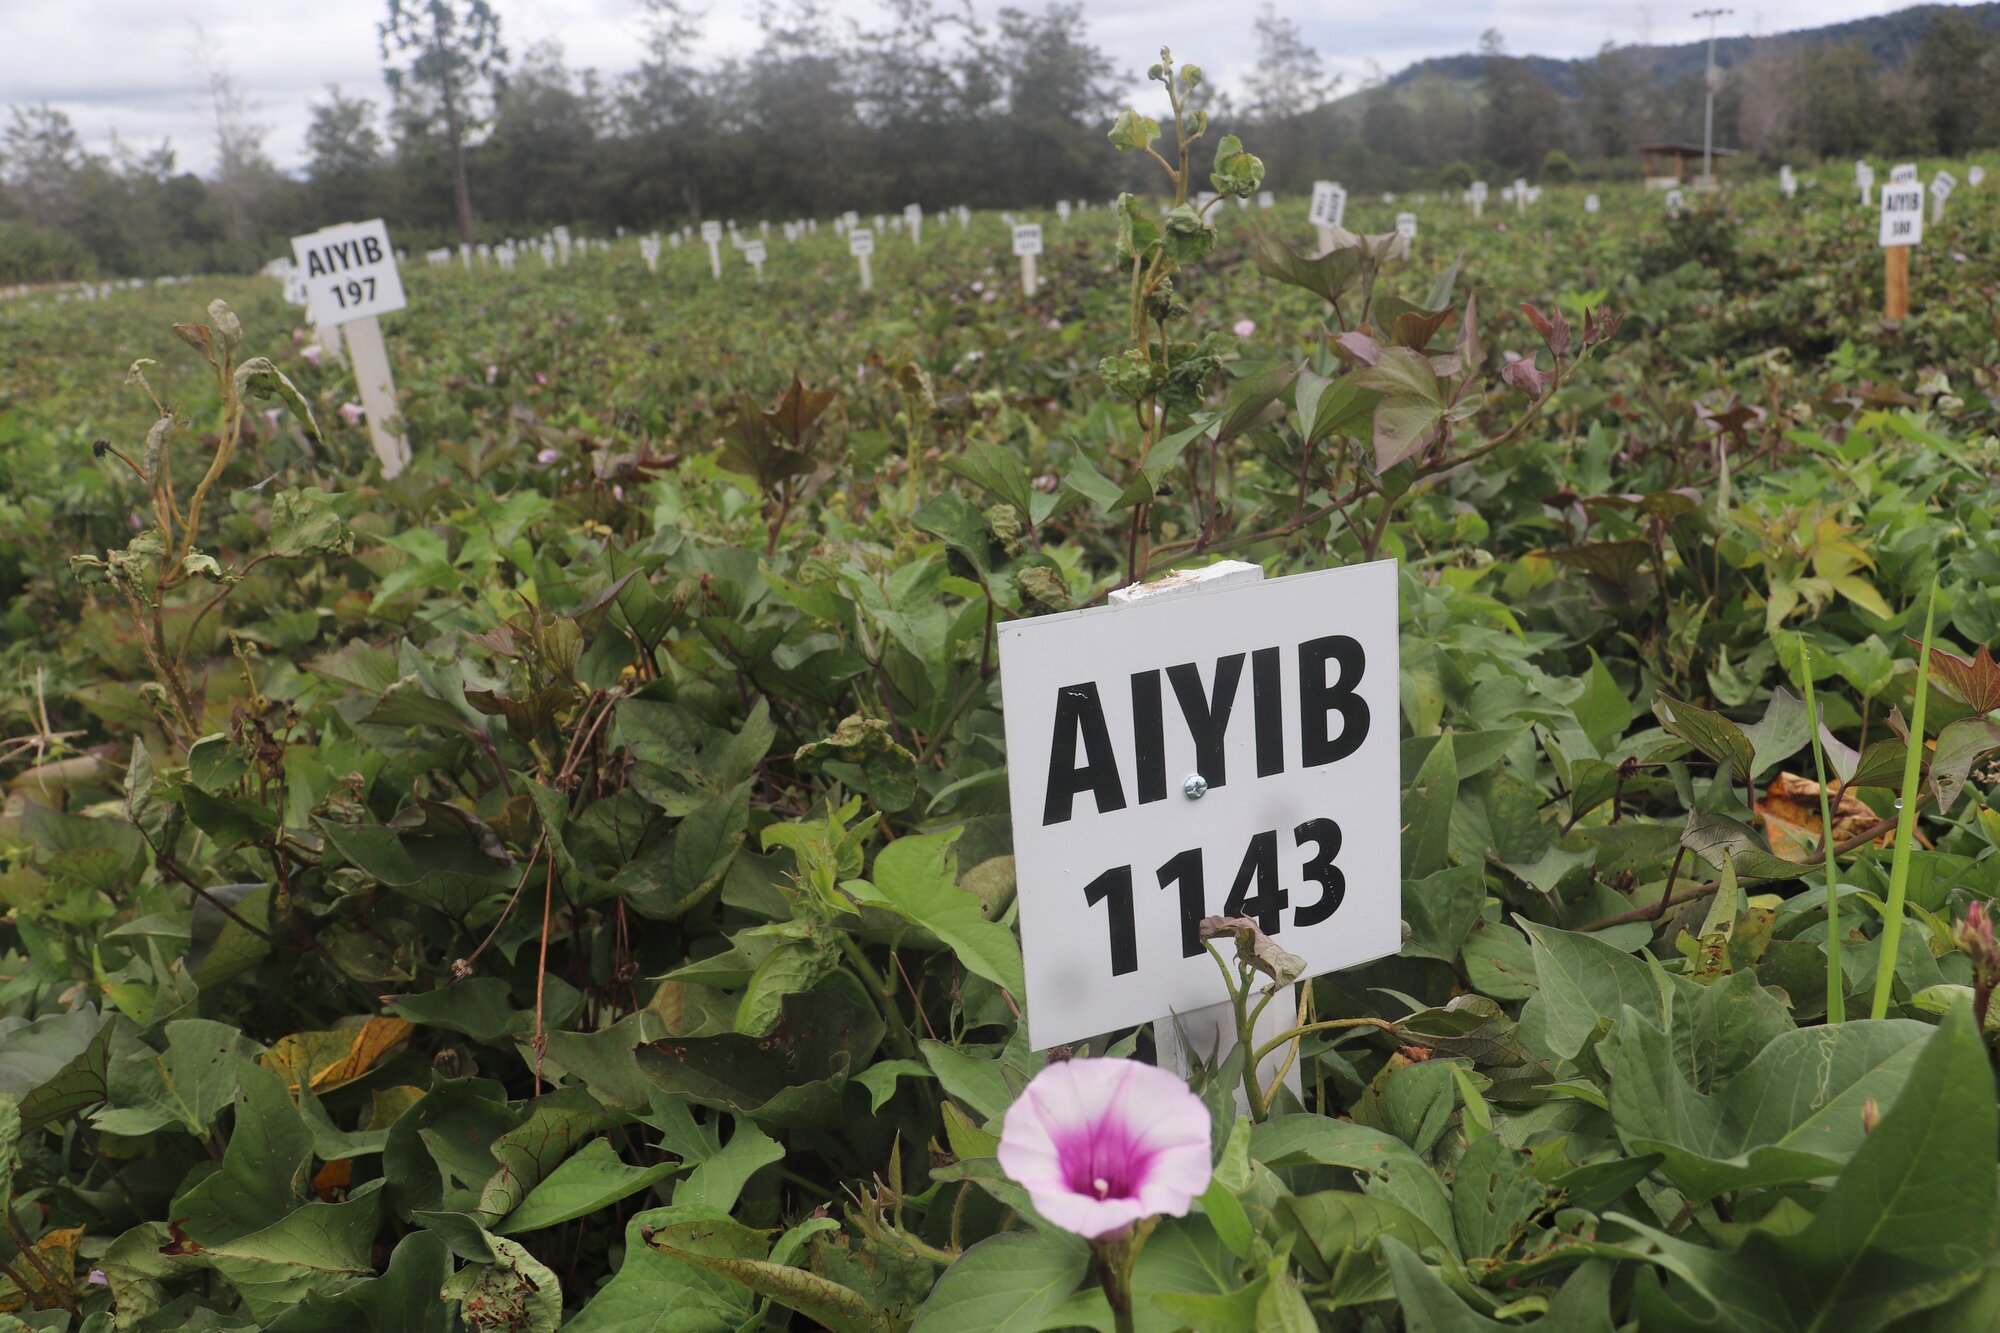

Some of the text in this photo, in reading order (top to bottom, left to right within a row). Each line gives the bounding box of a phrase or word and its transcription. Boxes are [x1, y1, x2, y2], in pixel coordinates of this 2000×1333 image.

[308, 237, 382, 278] AIYIB
[331, 277, 376, 308] 197
[1042, 634, 1371, 827] AIYIB
[1083, 817, 1346, 977] 1143
